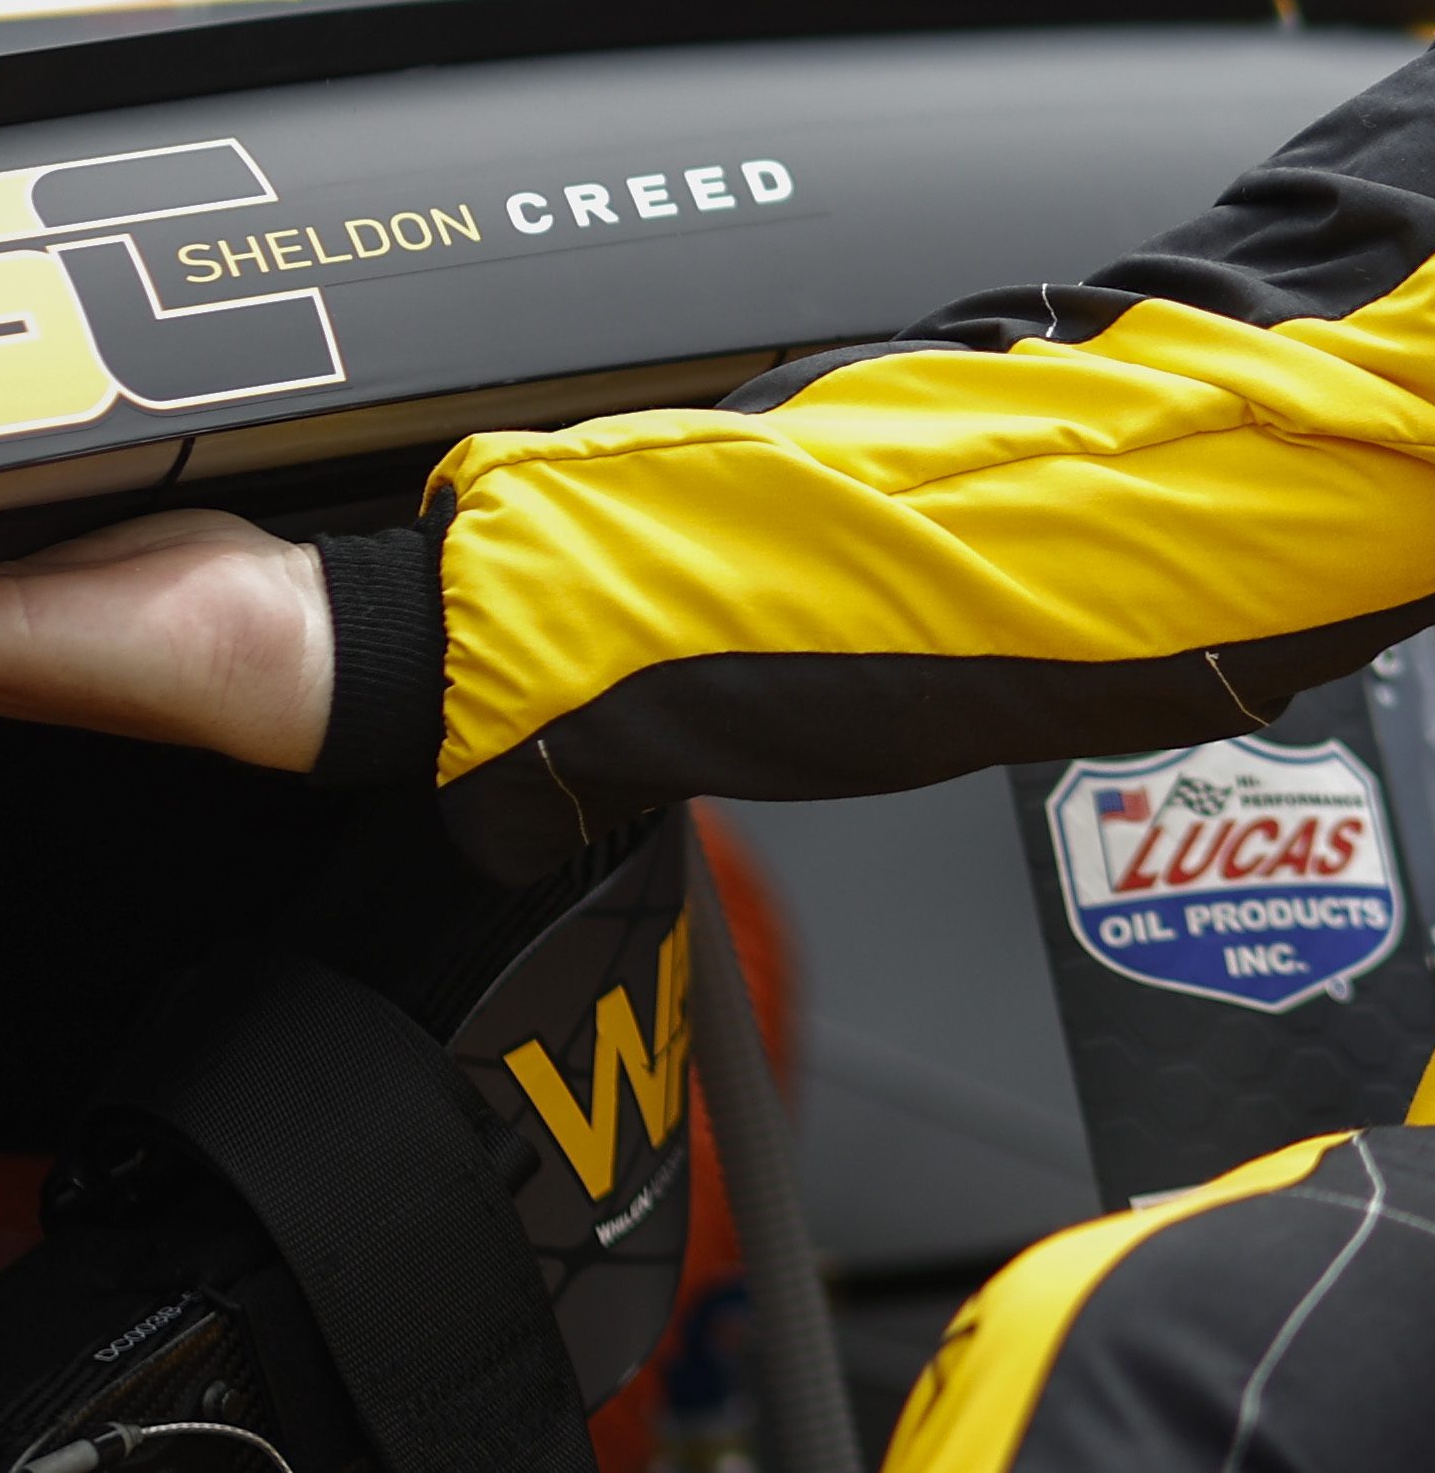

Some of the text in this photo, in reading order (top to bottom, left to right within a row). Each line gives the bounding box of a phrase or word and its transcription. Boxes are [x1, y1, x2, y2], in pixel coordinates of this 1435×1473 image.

[177, 158, 797, 285] SHELDON CREED
[1239, 792, 1365, 809] PERFORMANCE
[1112, 815, 1364, 894] LUCAS
[1097, 896, 1389, 948] OIL PRODUCTS
[1223, 943, 1311, 978] INC.
